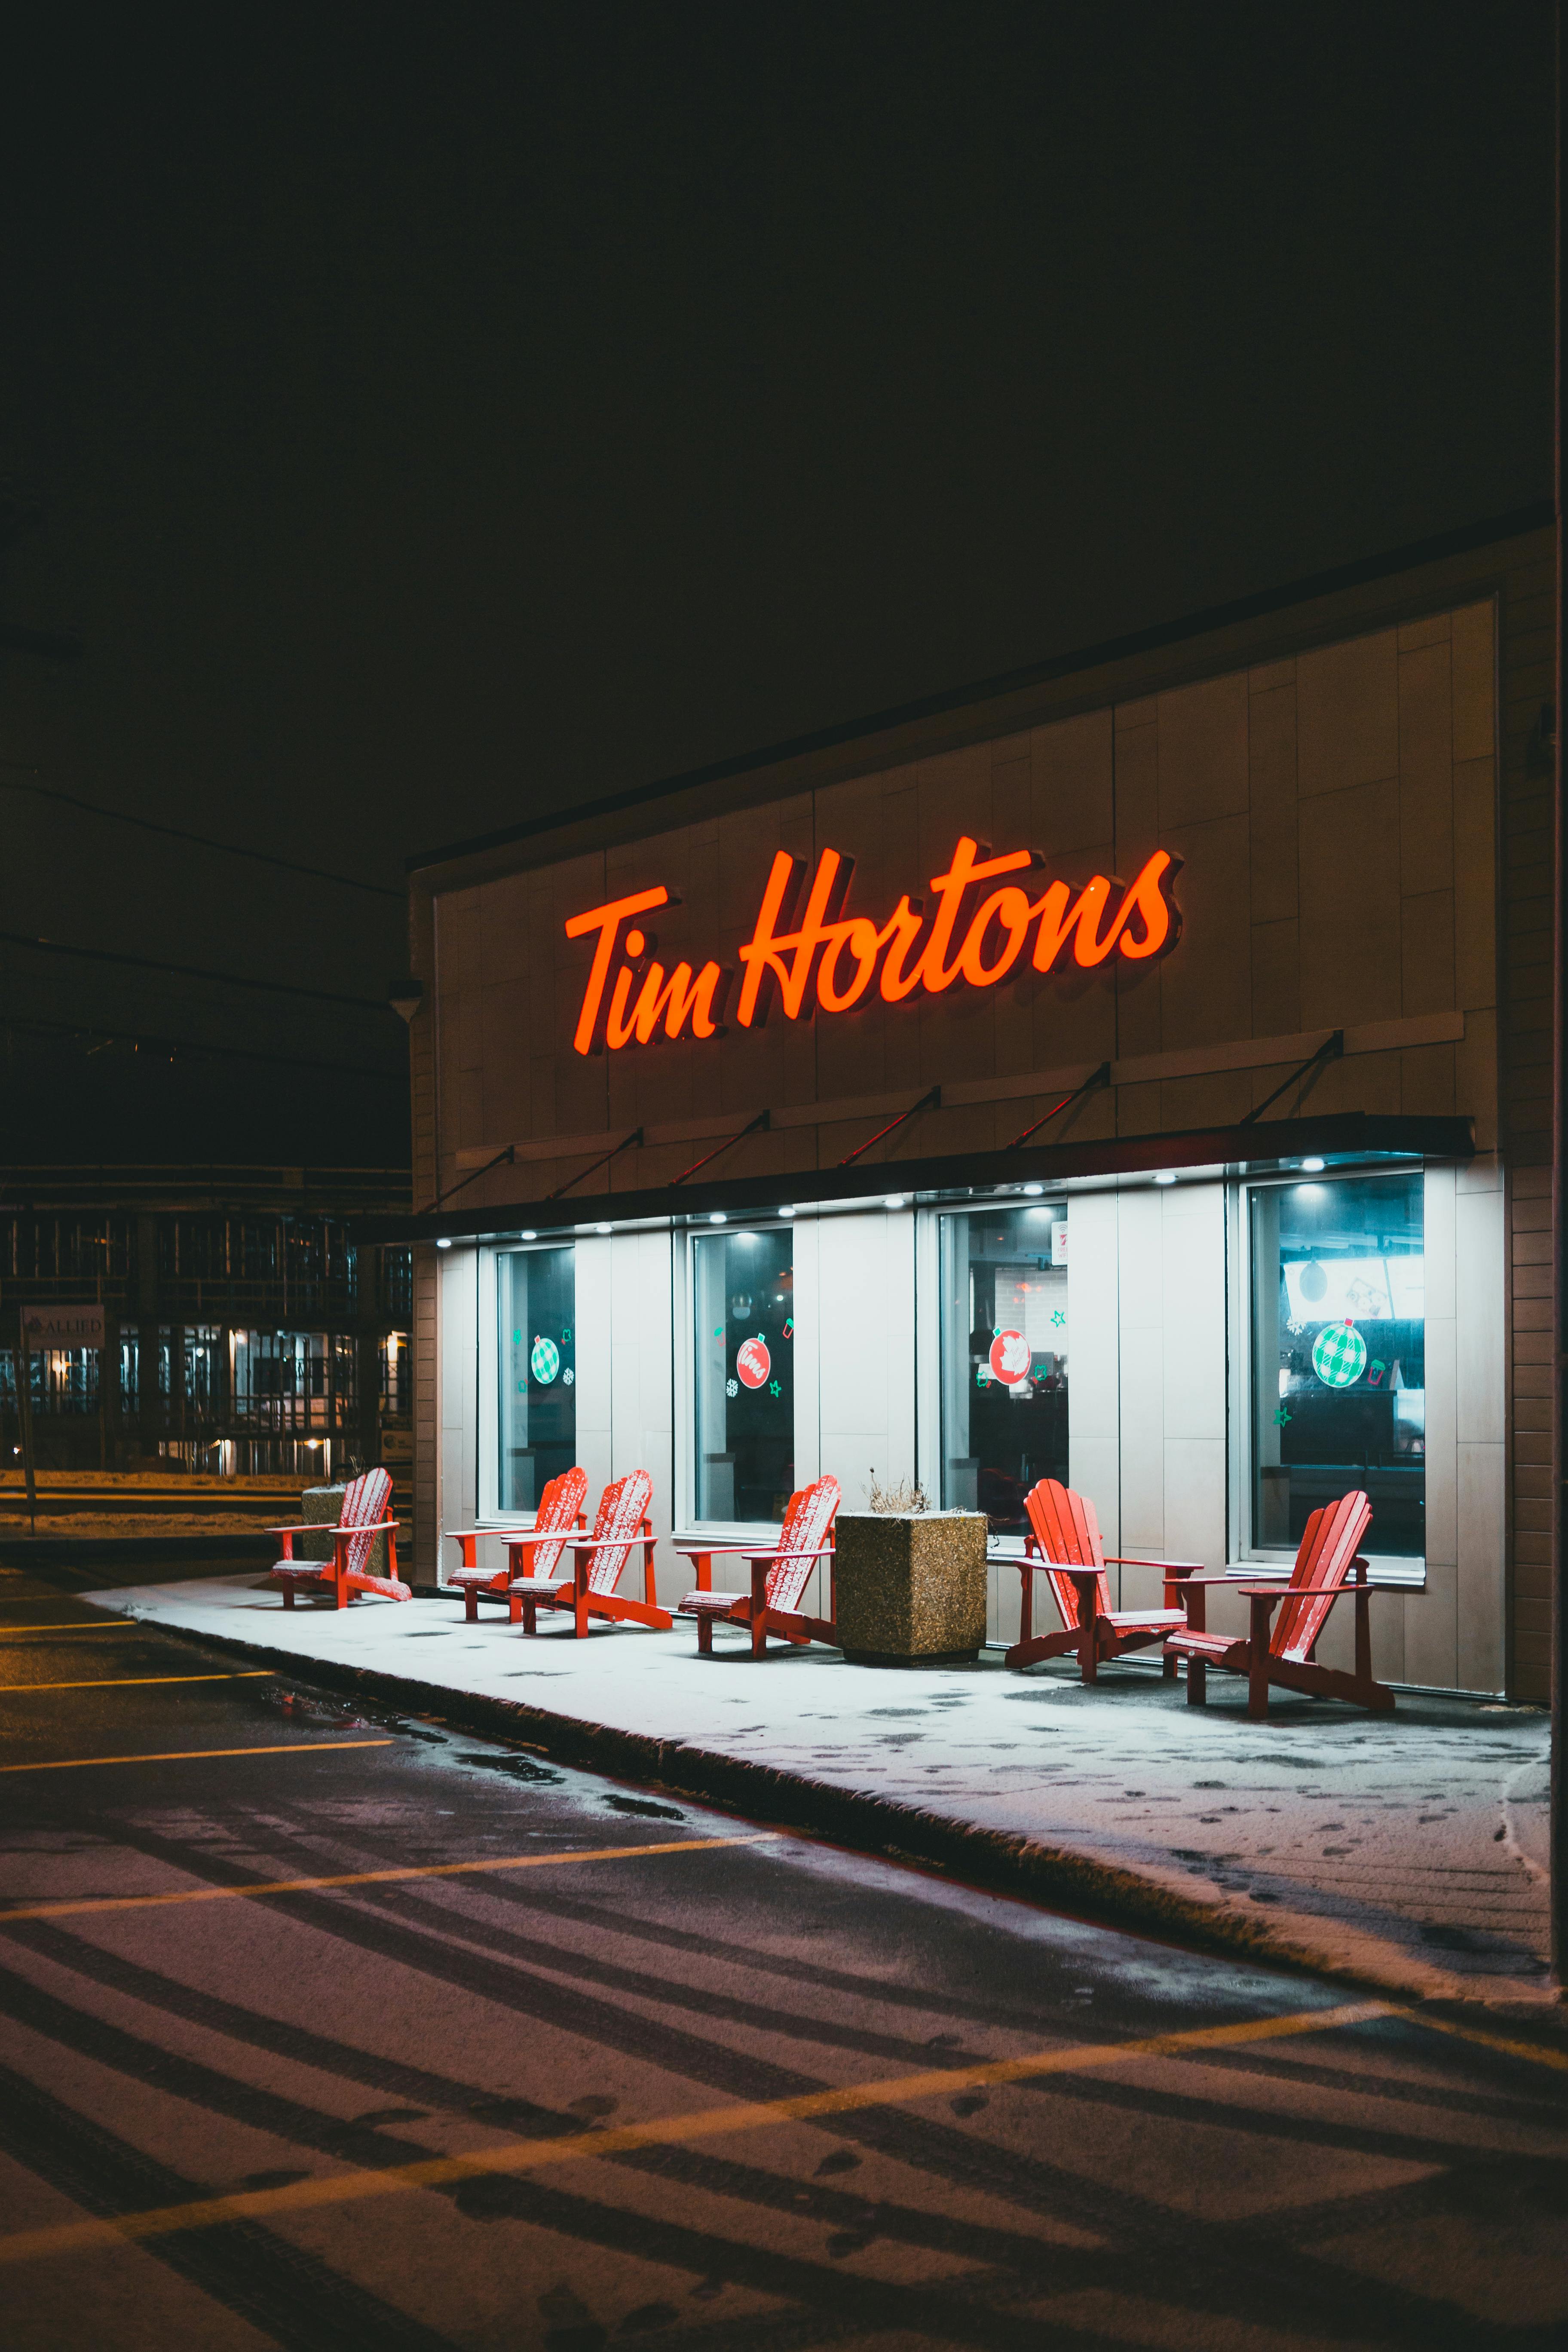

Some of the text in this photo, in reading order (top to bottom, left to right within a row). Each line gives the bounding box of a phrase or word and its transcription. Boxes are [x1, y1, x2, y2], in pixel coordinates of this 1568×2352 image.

[565, 836, 1171, 1056] Tim Hortons
[47, 1319, 101, 1332] ALLIED
[738, 1341, 766, 1379] Tims
